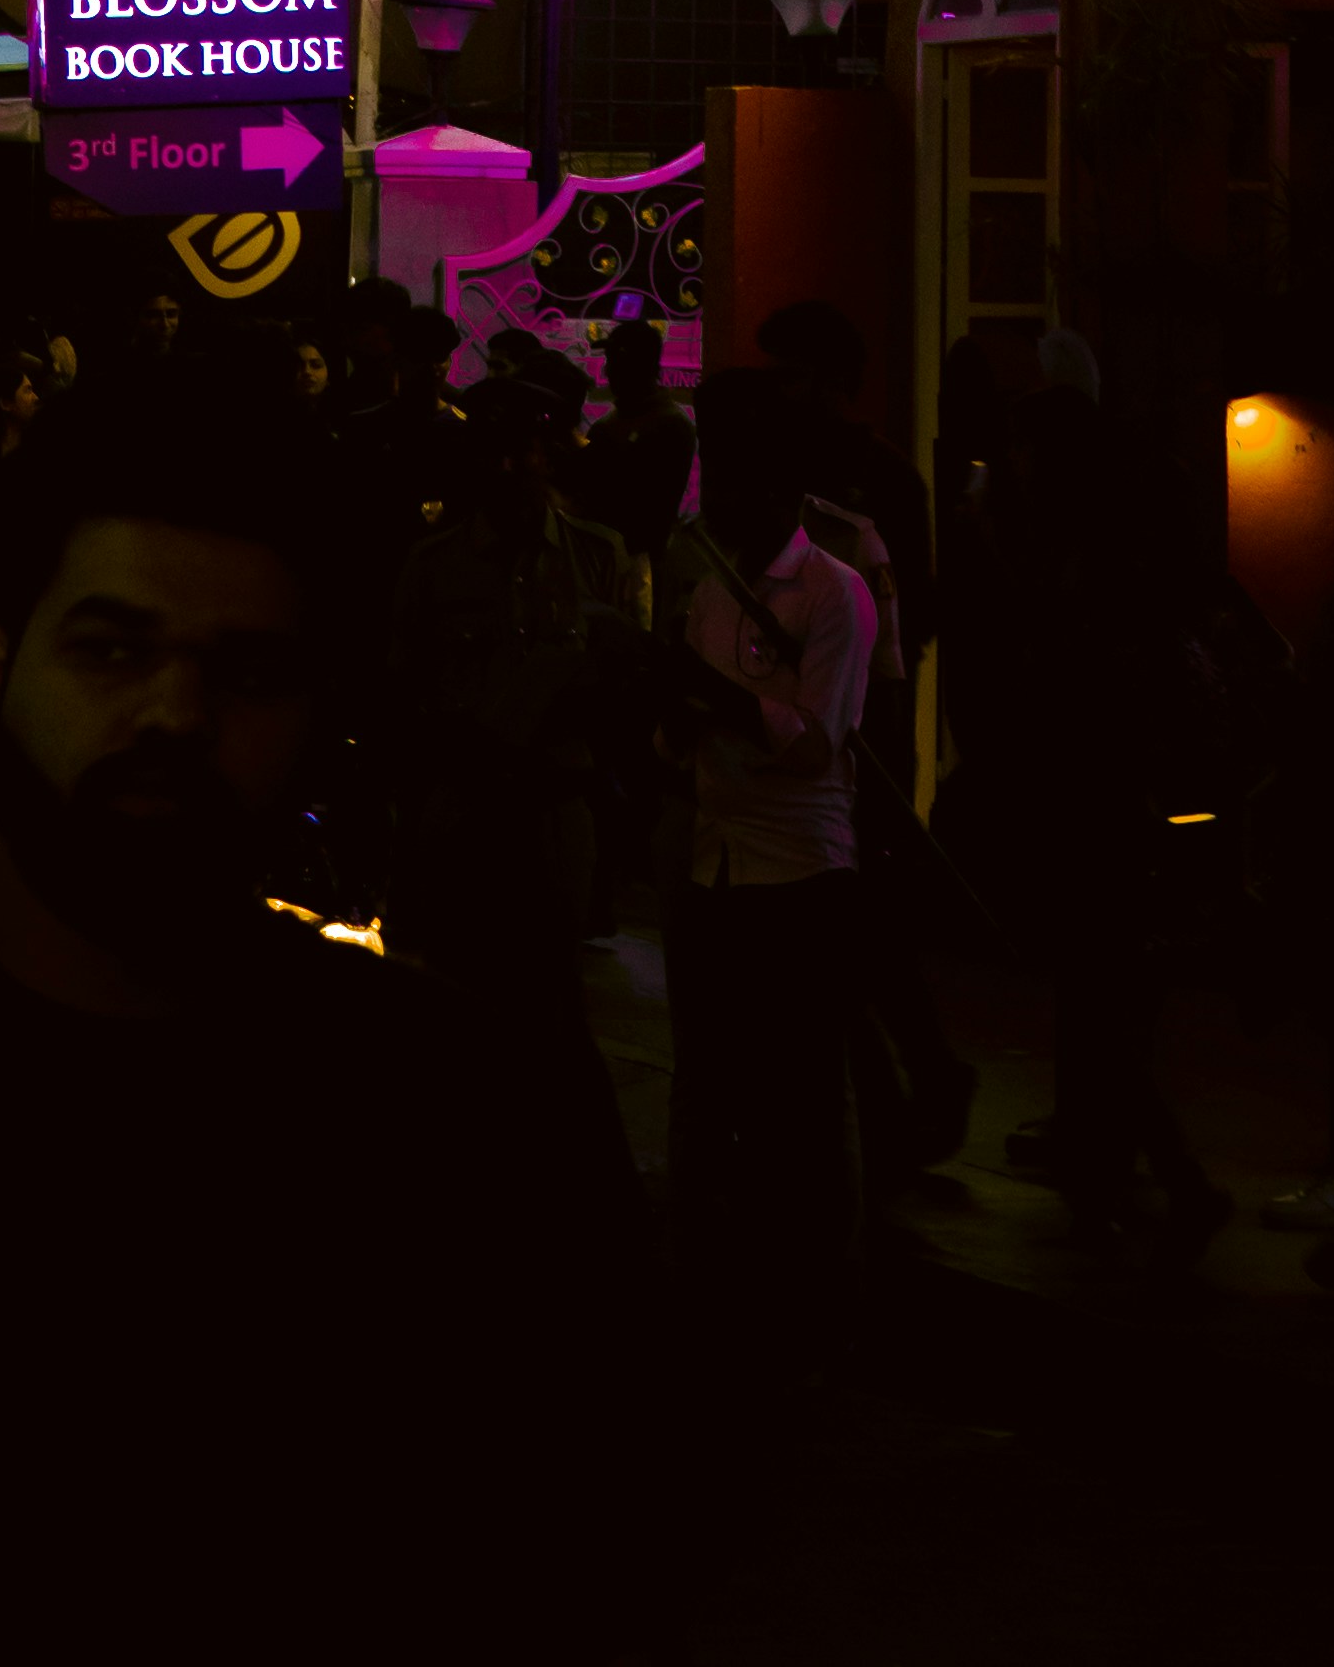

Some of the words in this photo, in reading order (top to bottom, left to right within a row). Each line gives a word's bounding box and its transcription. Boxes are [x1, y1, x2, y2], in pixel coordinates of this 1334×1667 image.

[64, 42, 194, 81] BOOK
[199, 36, 345, 76] HOUSE
[67, 130, 118, 173] 3rd
[127, 134, 227, 171] Floor
